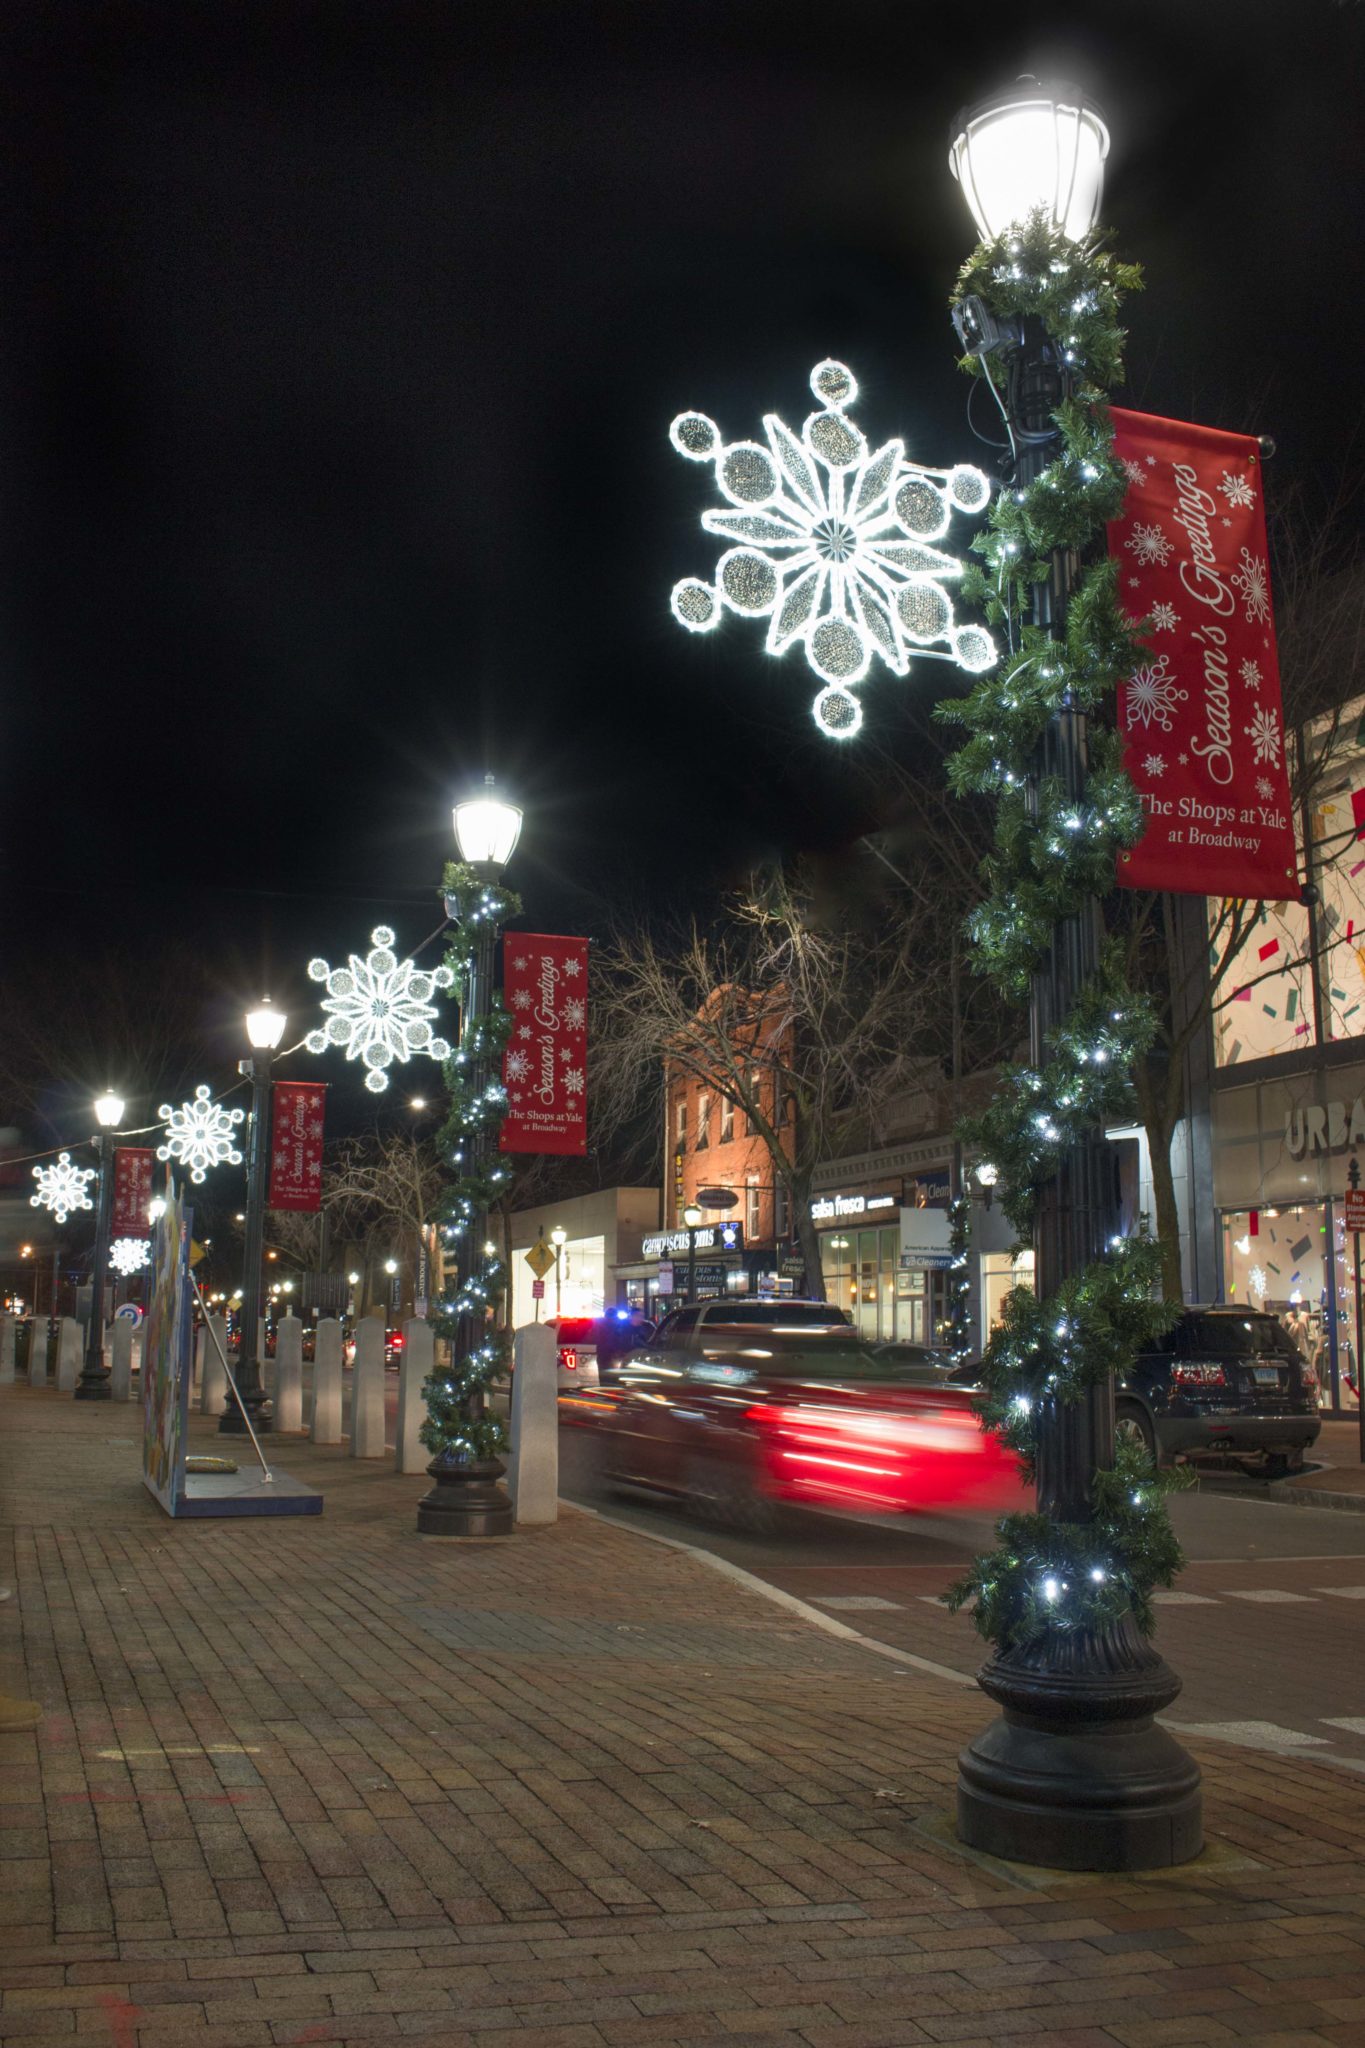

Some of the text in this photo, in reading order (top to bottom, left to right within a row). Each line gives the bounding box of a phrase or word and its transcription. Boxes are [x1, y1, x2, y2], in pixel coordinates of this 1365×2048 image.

[1173, 462, 1235, 785] Season's Greetings
[1136, 793, 1288, 829] The Shops at Yale
[1168, 827, 1261, 854] at Broadway
[533, 956, 560, 1105] Season's Greetings
[527, 1110, 555, 1123] Shops
[556, 1113, 565, 1121] at
[565, 1112, 583, 1123] Yale
[532, 1122, 567, 1134] Broadway
[811, 1198, 835, 1219] salsa
[835, 1195, 865, 1216] fresca
[1352, 1193, 1364, 1203] No
